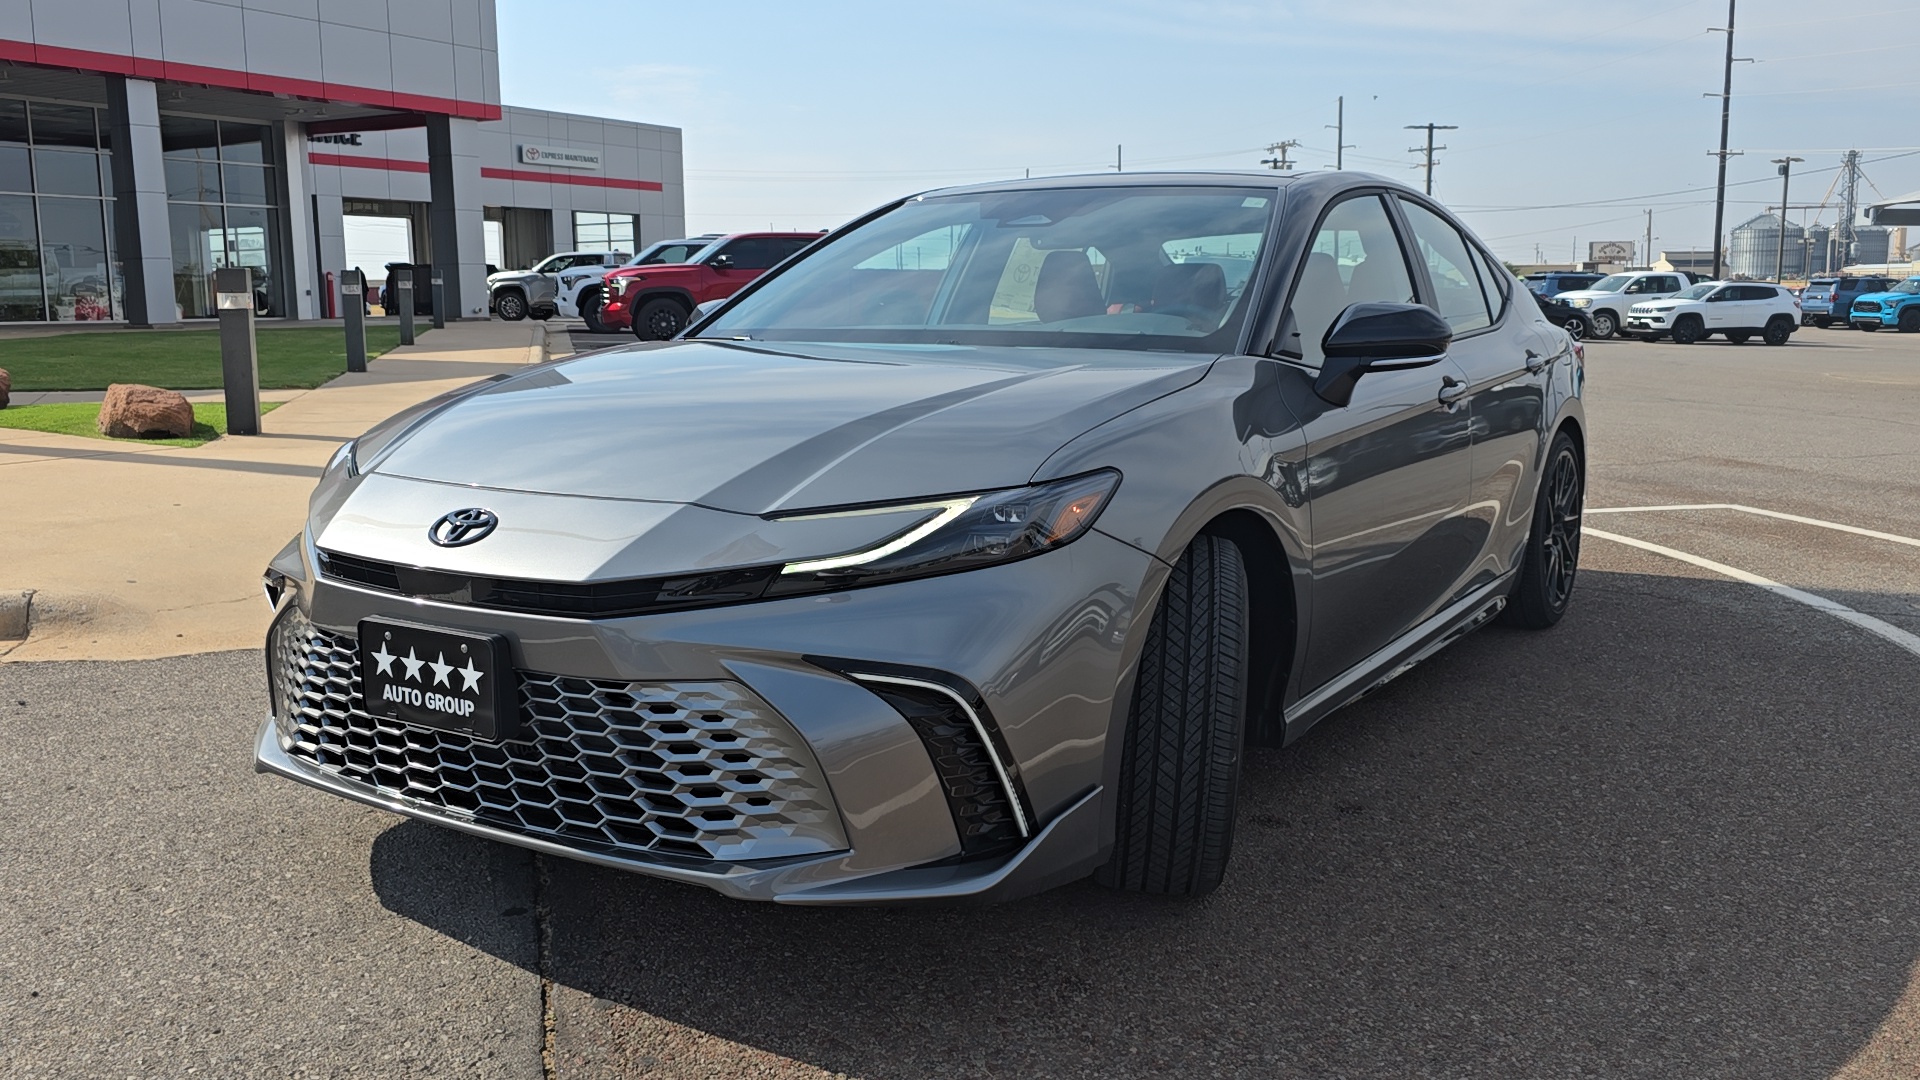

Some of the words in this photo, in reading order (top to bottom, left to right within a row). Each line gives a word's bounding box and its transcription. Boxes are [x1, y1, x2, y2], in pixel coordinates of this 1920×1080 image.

[541, 151, 564, 160] EXPRESS
[564, 154, 599, 164] MAINTENANCE
[382, 683, 422, 707] AUTO
[425, 692, 475, 717] GROUP
